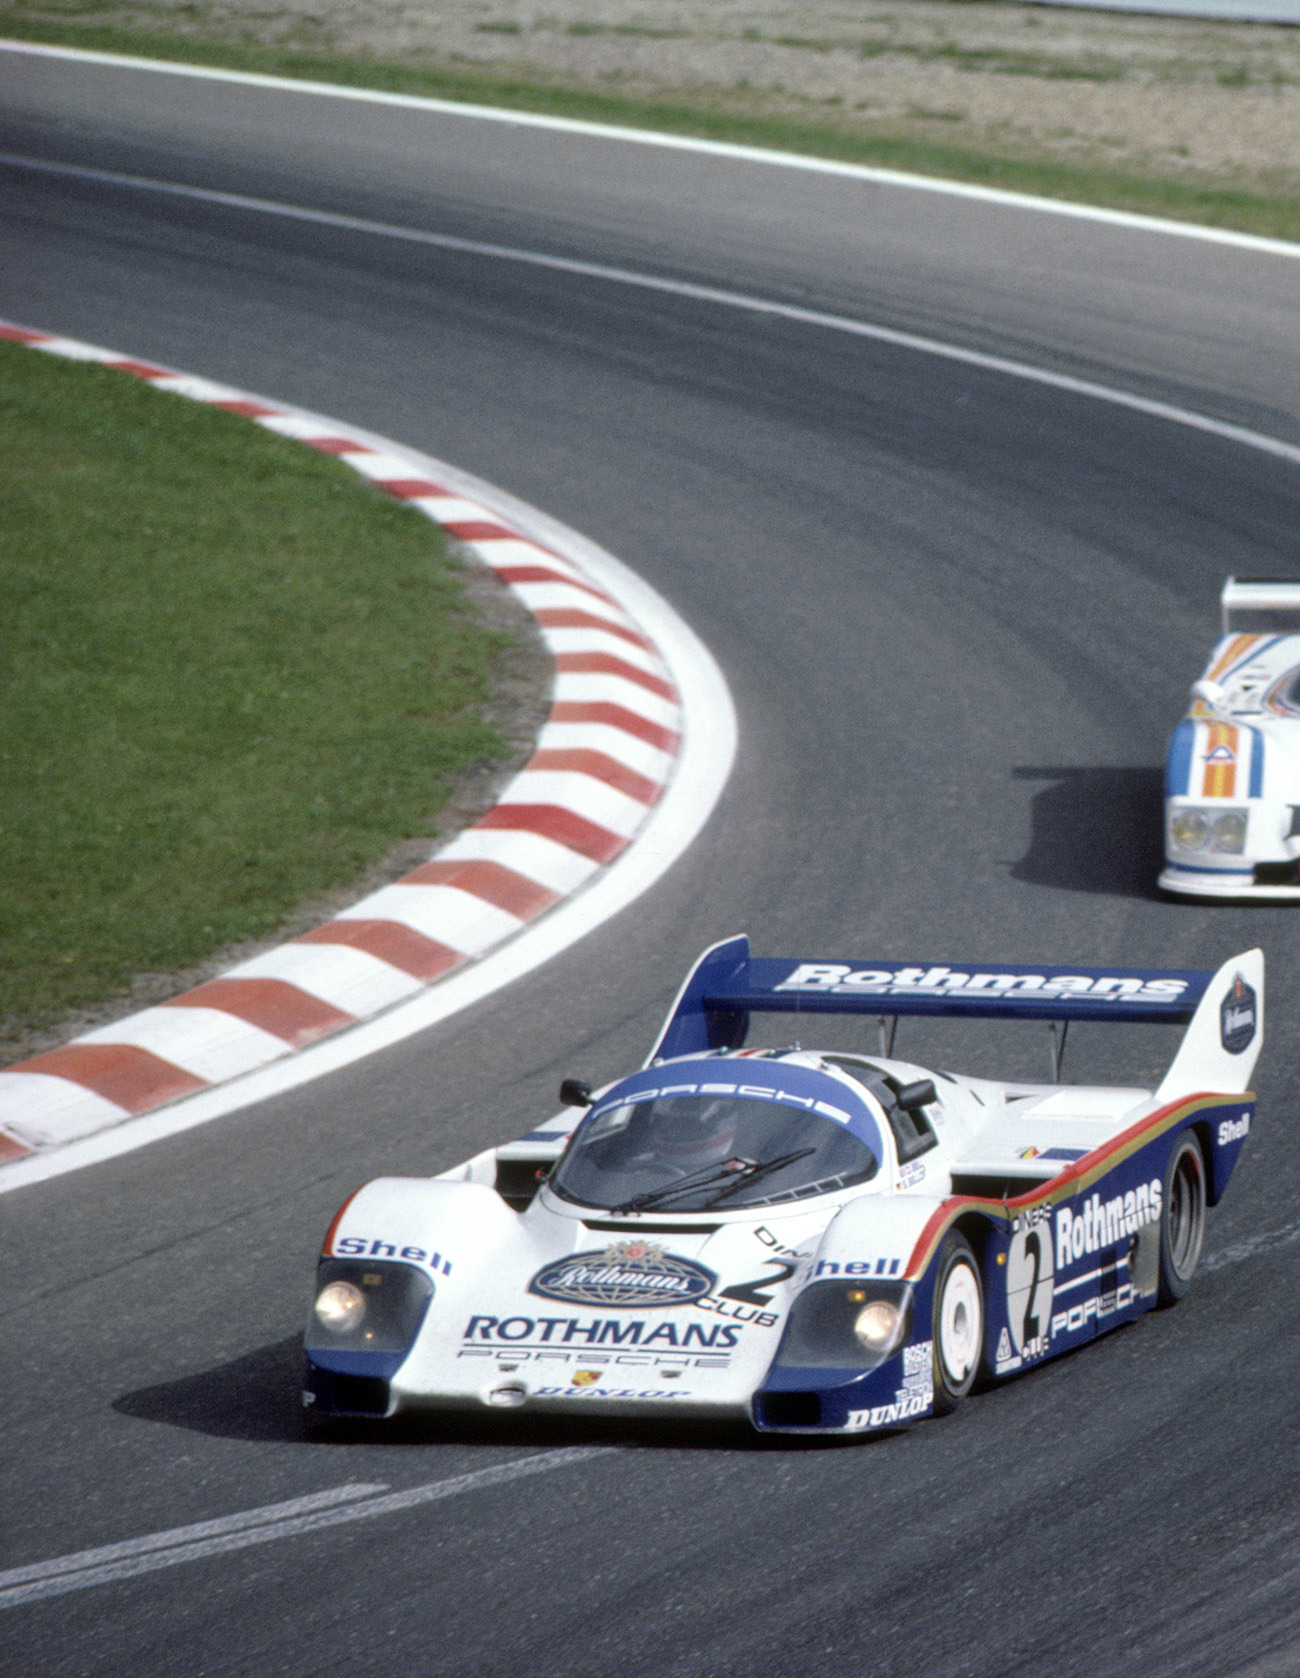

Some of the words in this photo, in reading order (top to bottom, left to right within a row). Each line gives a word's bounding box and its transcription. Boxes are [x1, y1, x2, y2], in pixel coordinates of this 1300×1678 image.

[787, 963, 1190, 995] Rothmans
[592, 1082, 852, 1125] PORSCHE
[1217, 1111, 1251, 1147] Shell
[1056, 1178, 1163, 1270] Rothmans
[336, 1237, 453, 1277] Shell
[753, 1225, 813, 1260] DIN
[548, 1265, 693, 1295] Rothmans
[717, 1256, 800, 1308] 2
[1022, 1230, 1042, 1345] 2
[693, 1295, 780, 1327] CLUB
[463, 1314, 743, 1349] ROTHMANS
[457, 1349, 732, 1369] PORSCHE
[534, 1386, 691, 1399] DUNLOP
[843, 1391, 934, 1429] DUNLOP
